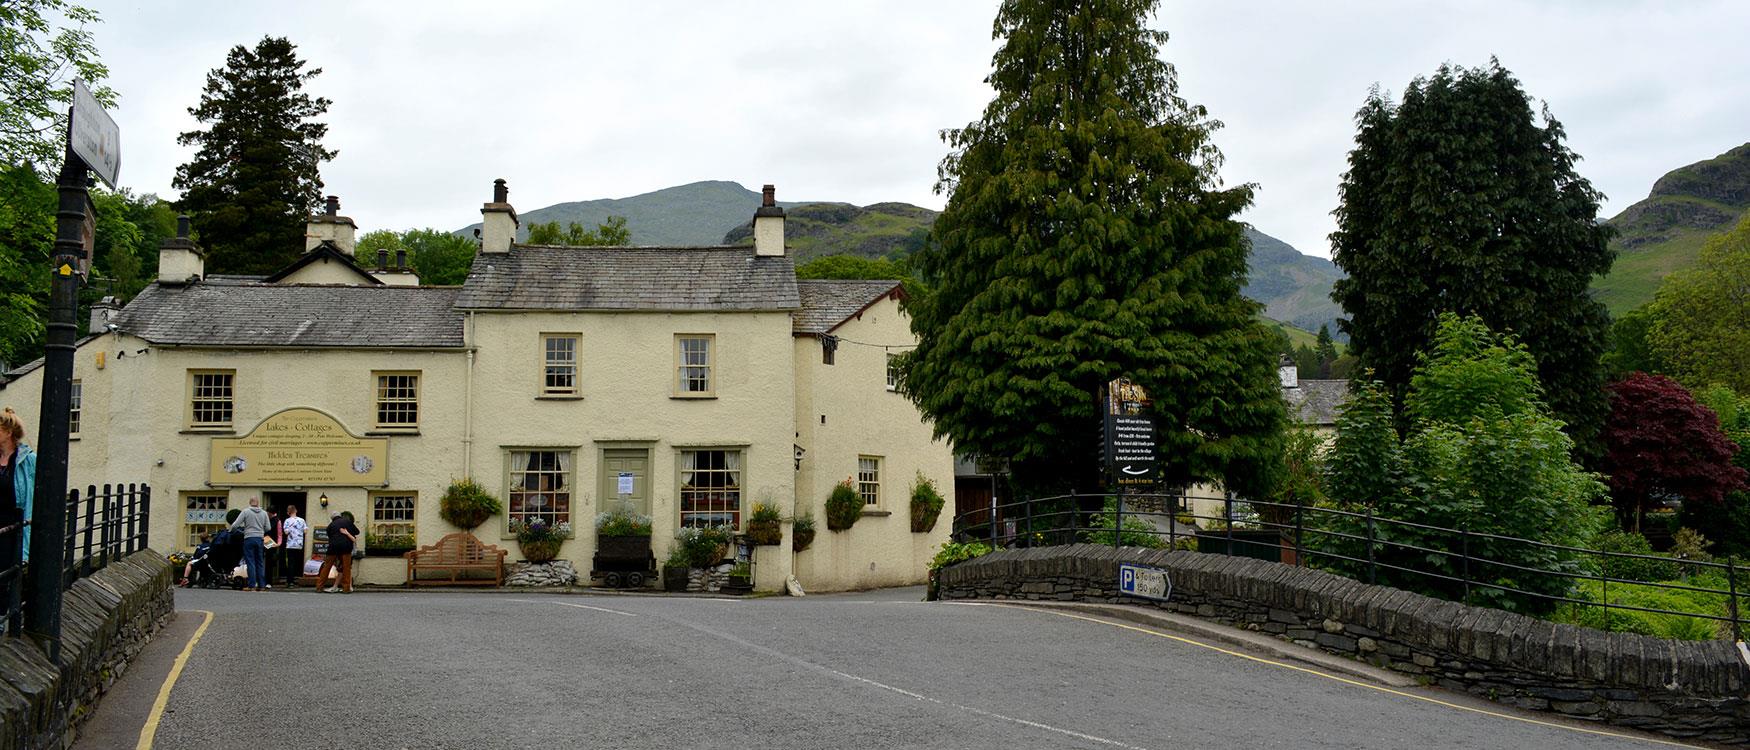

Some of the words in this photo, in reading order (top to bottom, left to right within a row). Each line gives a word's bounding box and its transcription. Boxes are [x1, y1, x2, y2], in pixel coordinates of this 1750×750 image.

[266, 423, 289, 432] Lakes
[294, 422, 333, 433] Cottages
[1124, 570, 1132, 588] P
[1137, 583, 1148, 592] 150
[1149, 586, 1160, 594] yds
